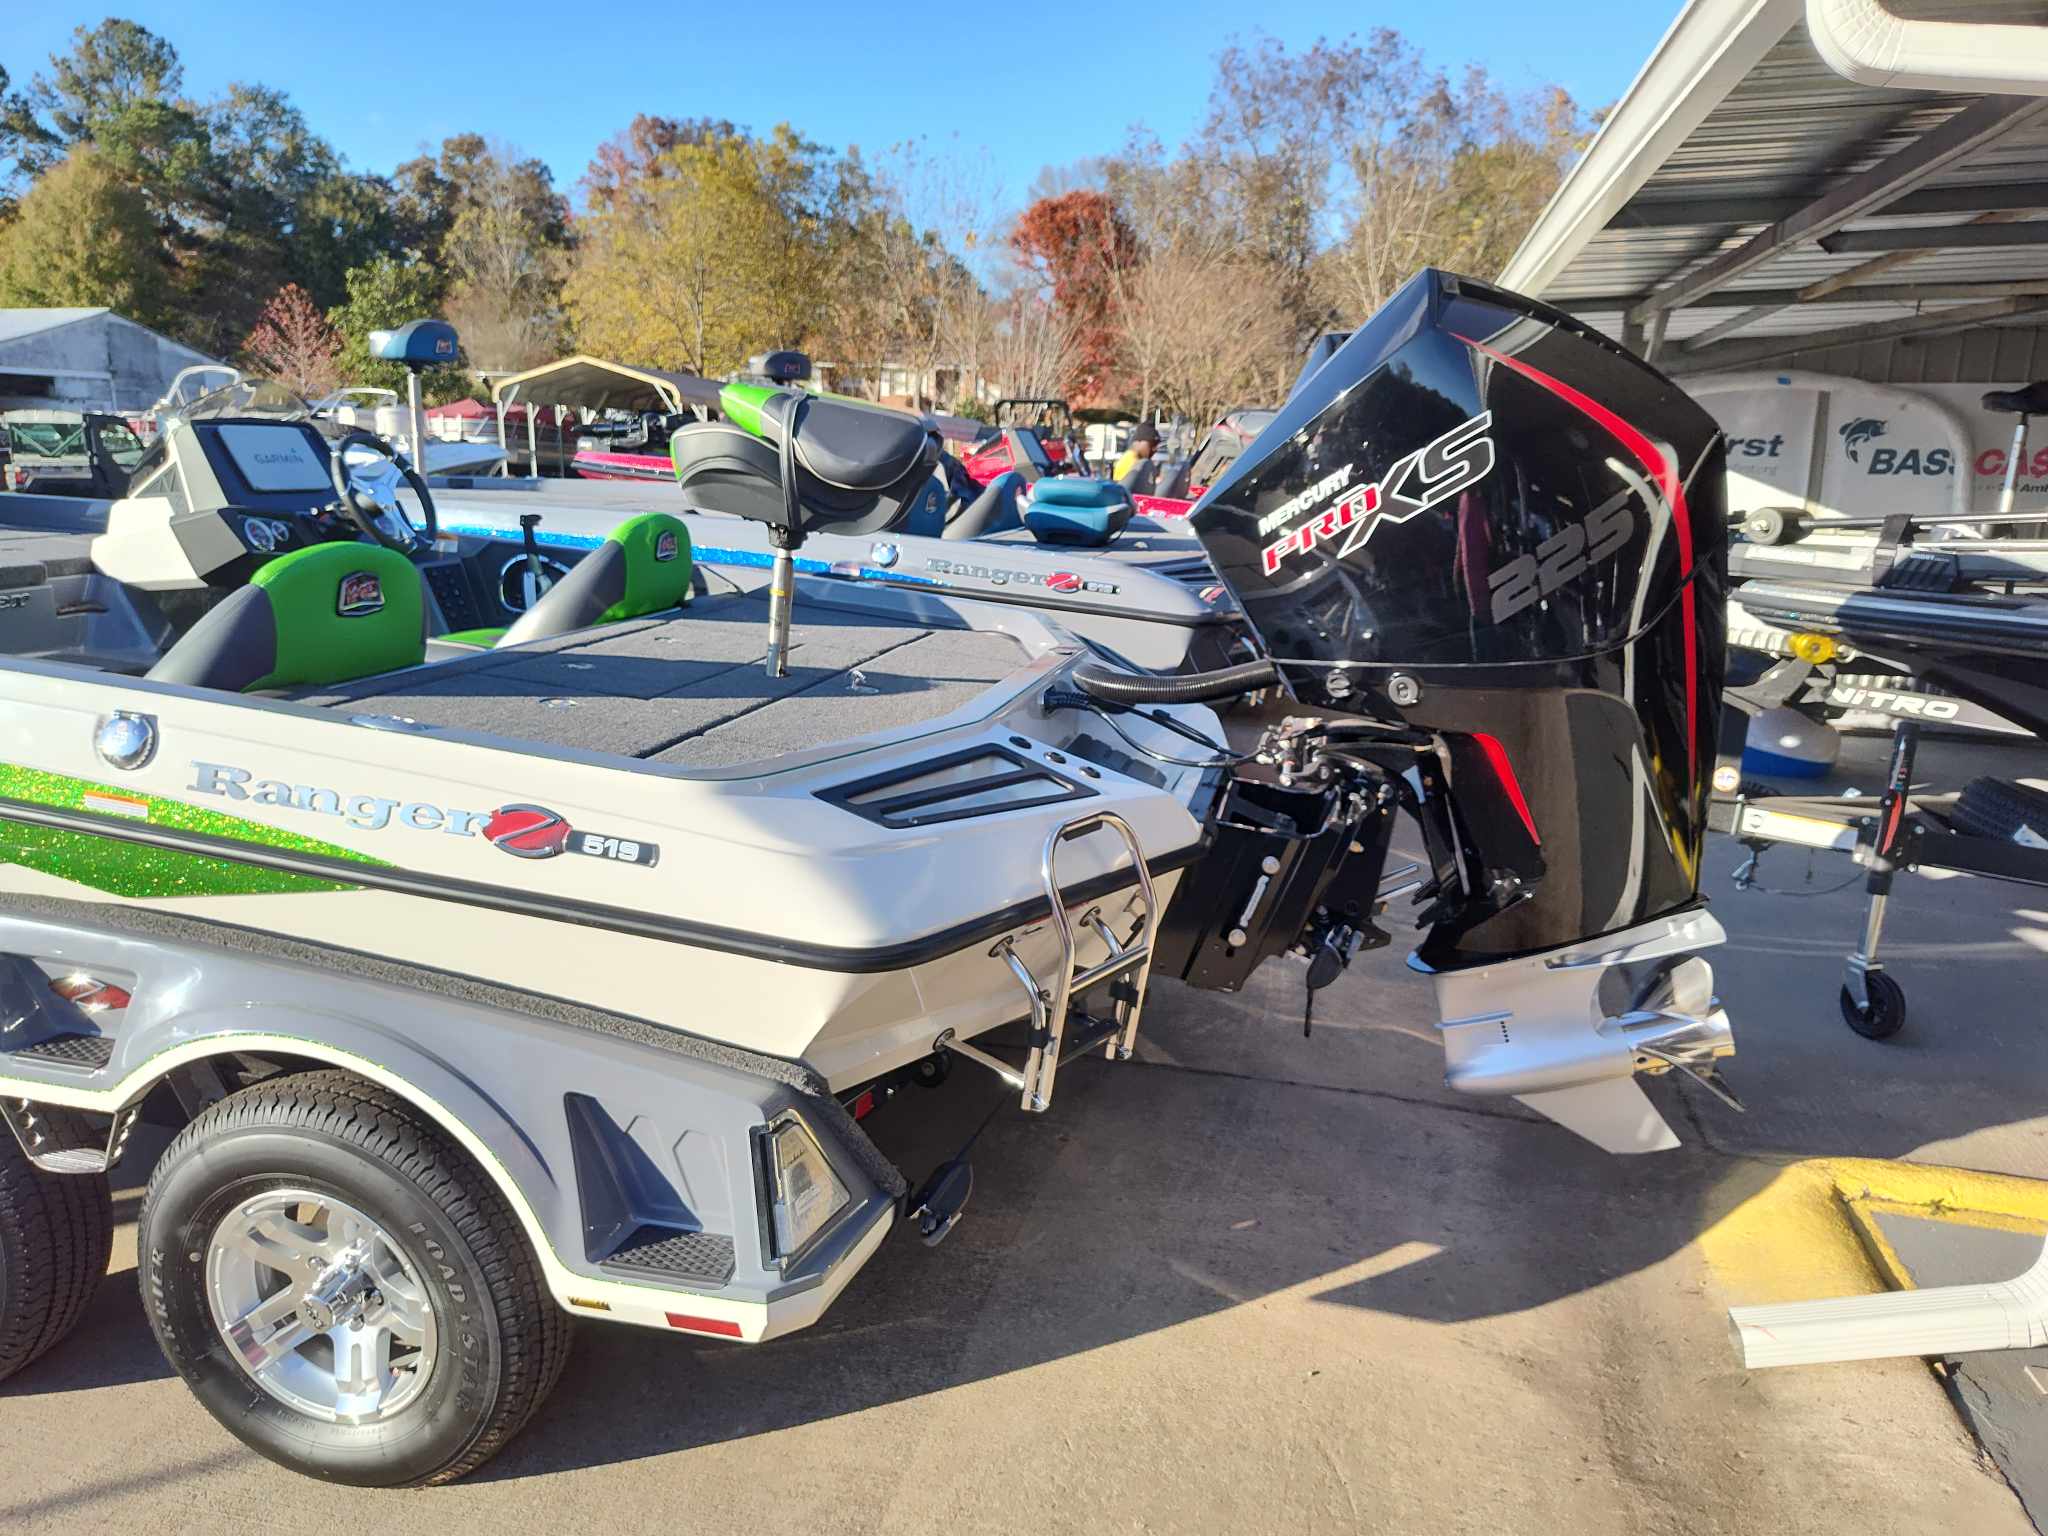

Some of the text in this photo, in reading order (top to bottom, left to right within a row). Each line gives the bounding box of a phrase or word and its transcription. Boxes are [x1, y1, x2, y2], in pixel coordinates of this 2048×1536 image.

[1725, 433, 1784, 457] rst
[1868, 448, 1955, 476] BAS
[1258, 463, 1354, 537] MERCURY
[1261, 409, 1496, 577] PRO XS
[926, 558, 1048, 585] Ranger
[1487, 488, 1634, 625] 225
[186, 760, 494, 837] Ranger
[583, 836, 640, 861] 519
